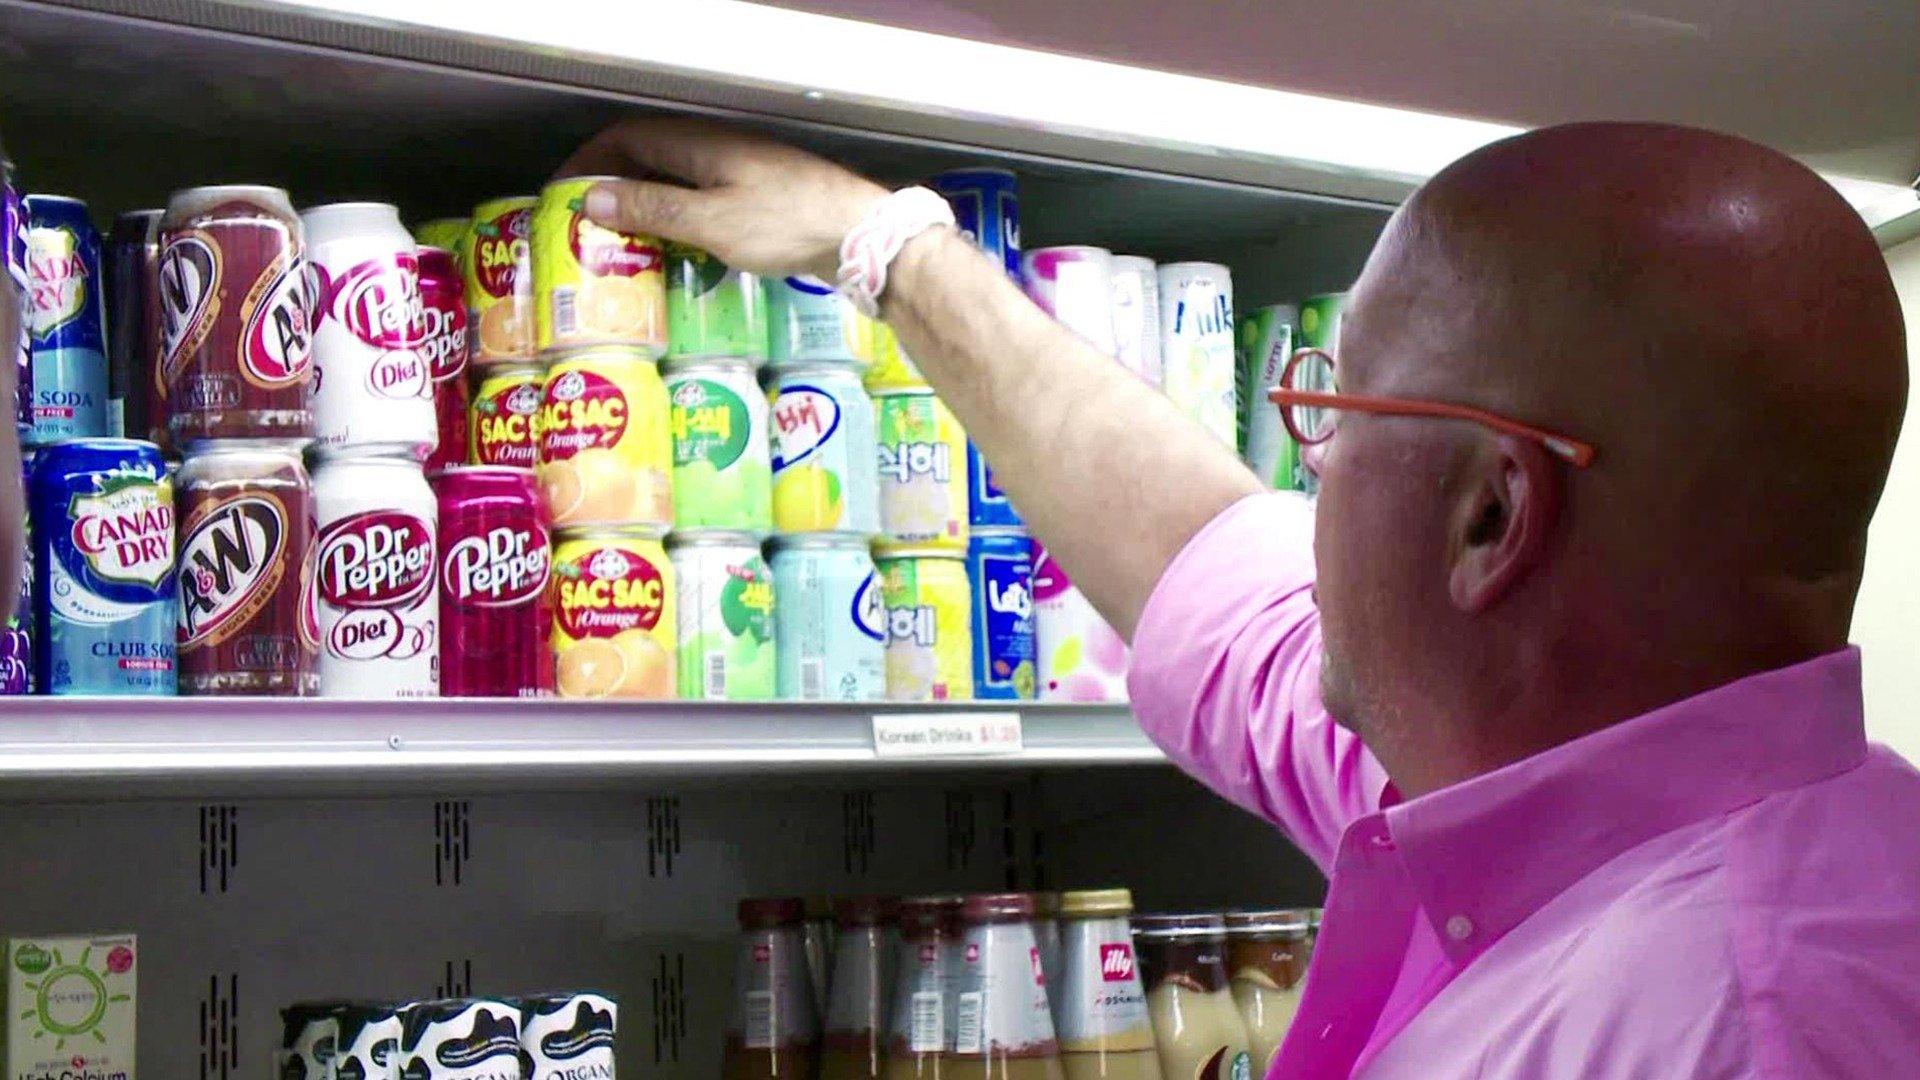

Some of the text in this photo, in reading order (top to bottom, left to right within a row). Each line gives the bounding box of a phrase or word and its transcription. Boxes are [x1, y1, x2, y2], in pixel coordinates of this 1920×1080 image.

[381, 360, 418, 389] Diet
[41, 390, 93, 407] SODA
[570, 396, 625, 428] SAC
[481, 414, 526, 443] SAC
[496, 443, 537, 461] Oran
[116, 533, 168, 568] DRY
[365, 524, 410, 562] Dr
[489, 527, 530, 564] Dr
[180, 506, 253, 638] A&W
[327, 533, 430, 598] Pepper
[453, 536, 548, 598] Pepper
[561, 580, 610, 609] SAC
[612, 579, 662, 608] SAC
[342, 618, 387, 648] Diet
[580, 610, 640, 629] Orange
[92, 641, 146, 656] CLUB
[1103, 949, 1132, 977] illy
